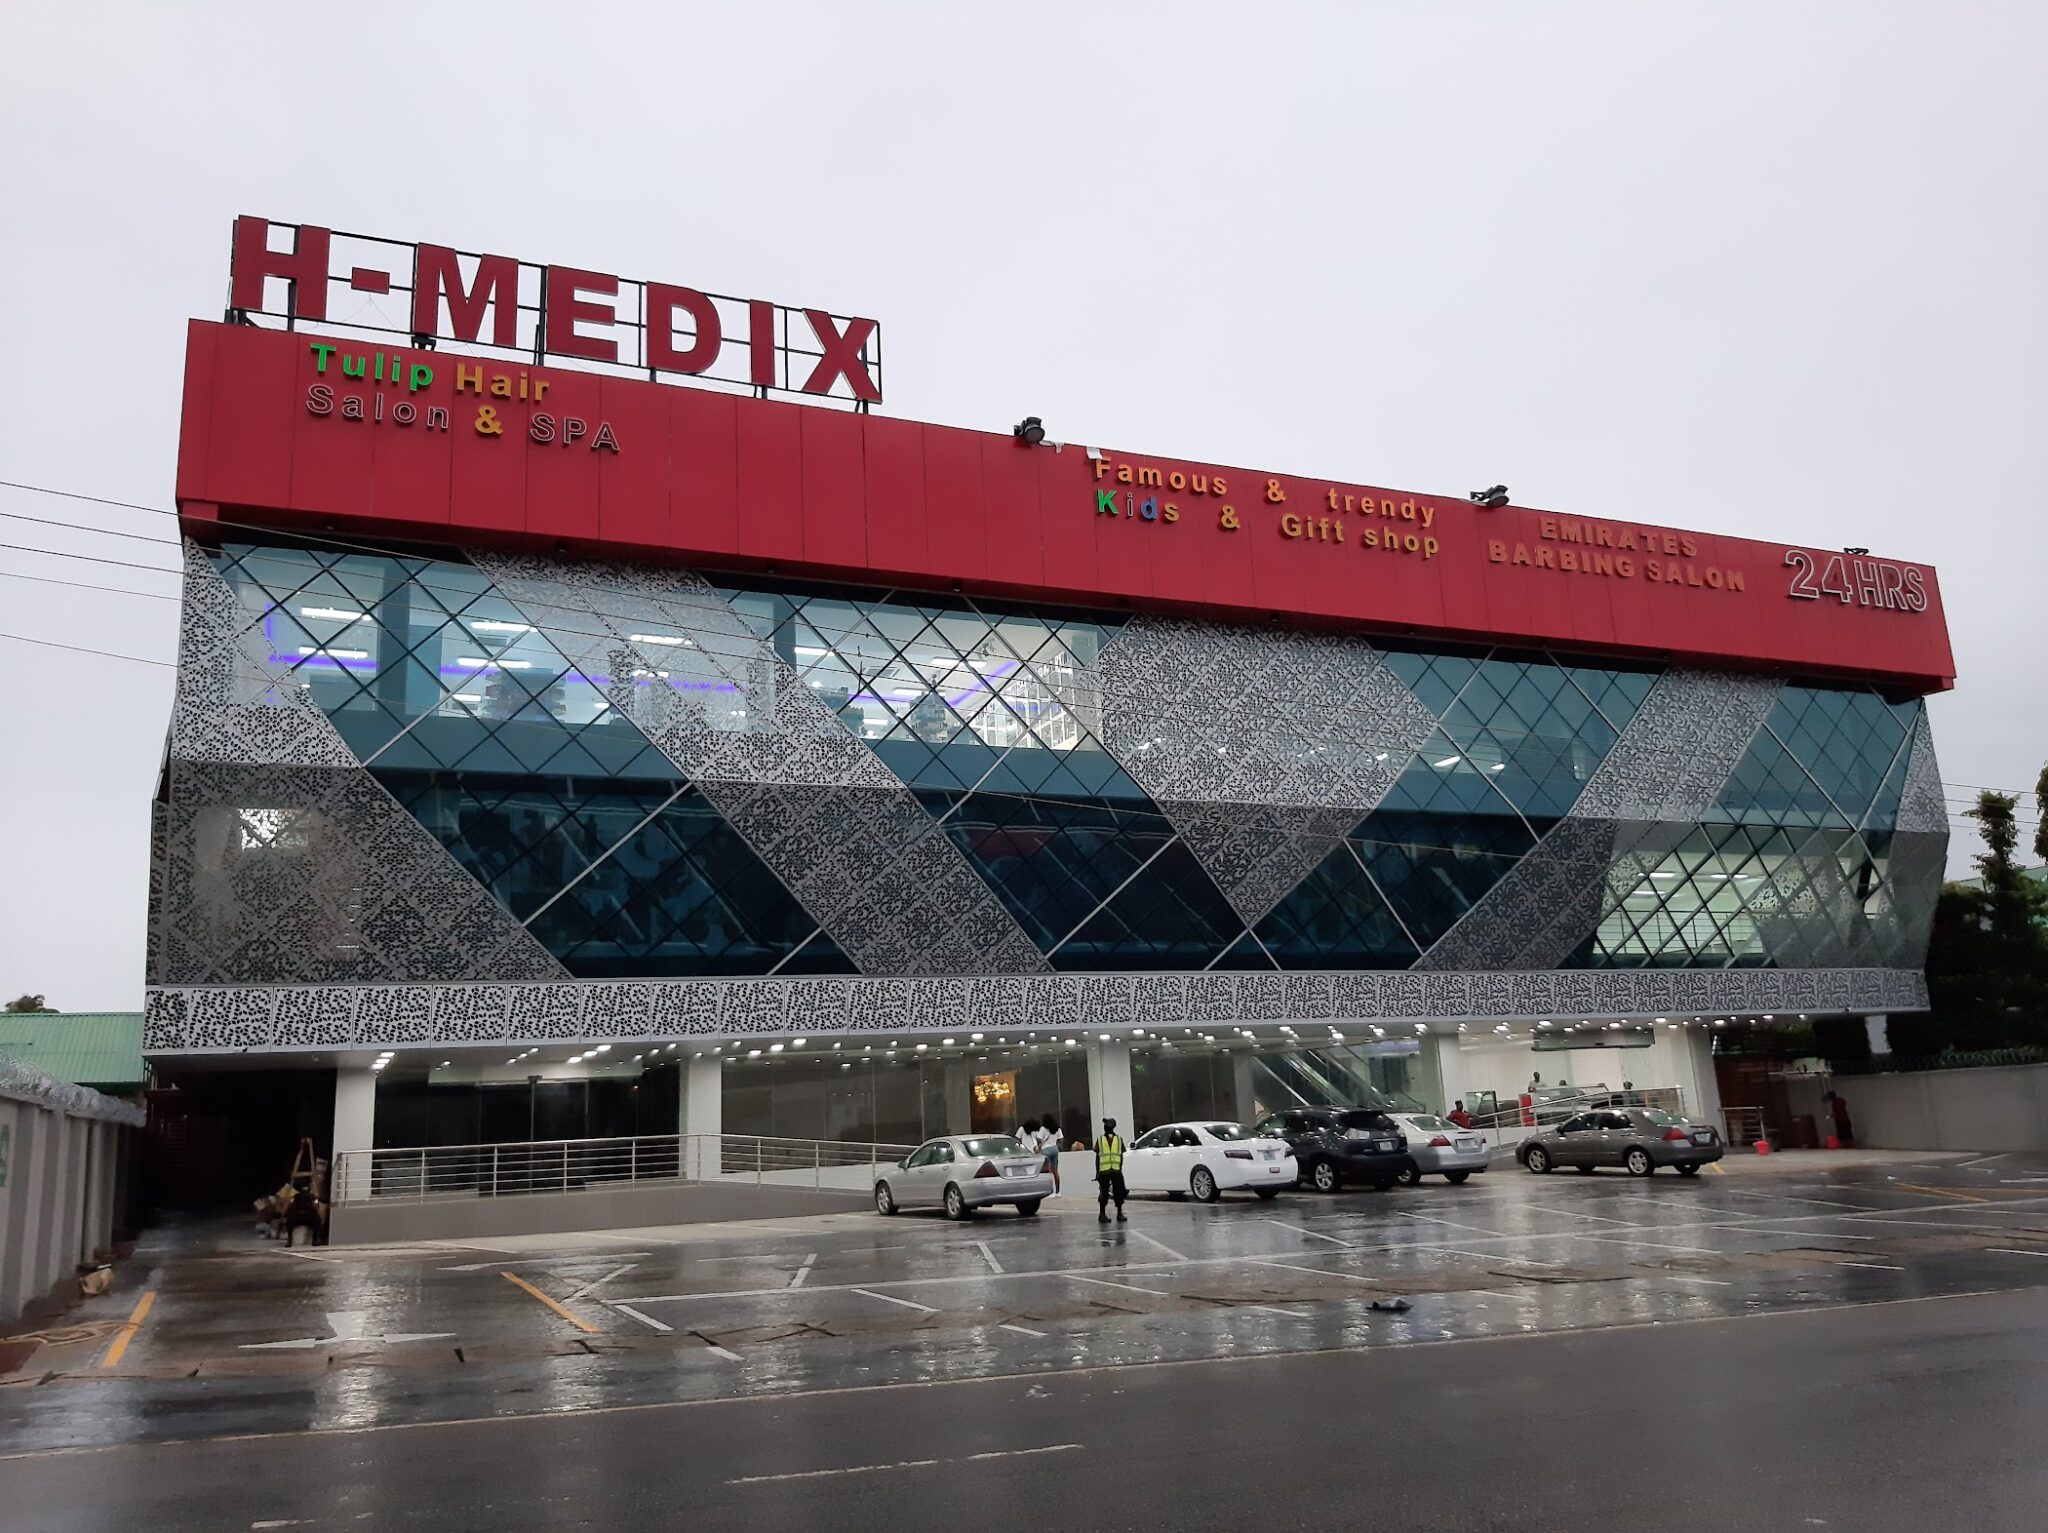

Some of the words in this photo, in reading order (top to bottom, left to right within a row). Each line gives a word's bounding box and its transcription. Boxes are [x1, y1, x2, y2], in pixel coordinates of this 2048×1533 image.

[231, 215, 882, 404] H-MEDIX
[311, 343, 433, 391] Tulip
[457, 363, 549, 401] Hair
[306, 384, 449, 429] Salon
[475, 405, 503, 435] &
[530, 413, 620, 451] SPA
[1096, 456, 1228, 495] Famous
[1267, 479, 1286, 502] &
[1329, 487, 1435, 528] trendy
[1097, 489, 1180, 521] Kids
[1221, 505, 1240, 529] &
[1282, 513, 1344, 542] Gift
[1364, 526, 1439, 559] shop
[1489, 540, 1635, 577] BARBING
[1648, 560, 1745, 592] SALON
[1540, 517, 1697, 557] EMIRATES
[1785, 550, 1927, 612] 24HRS
